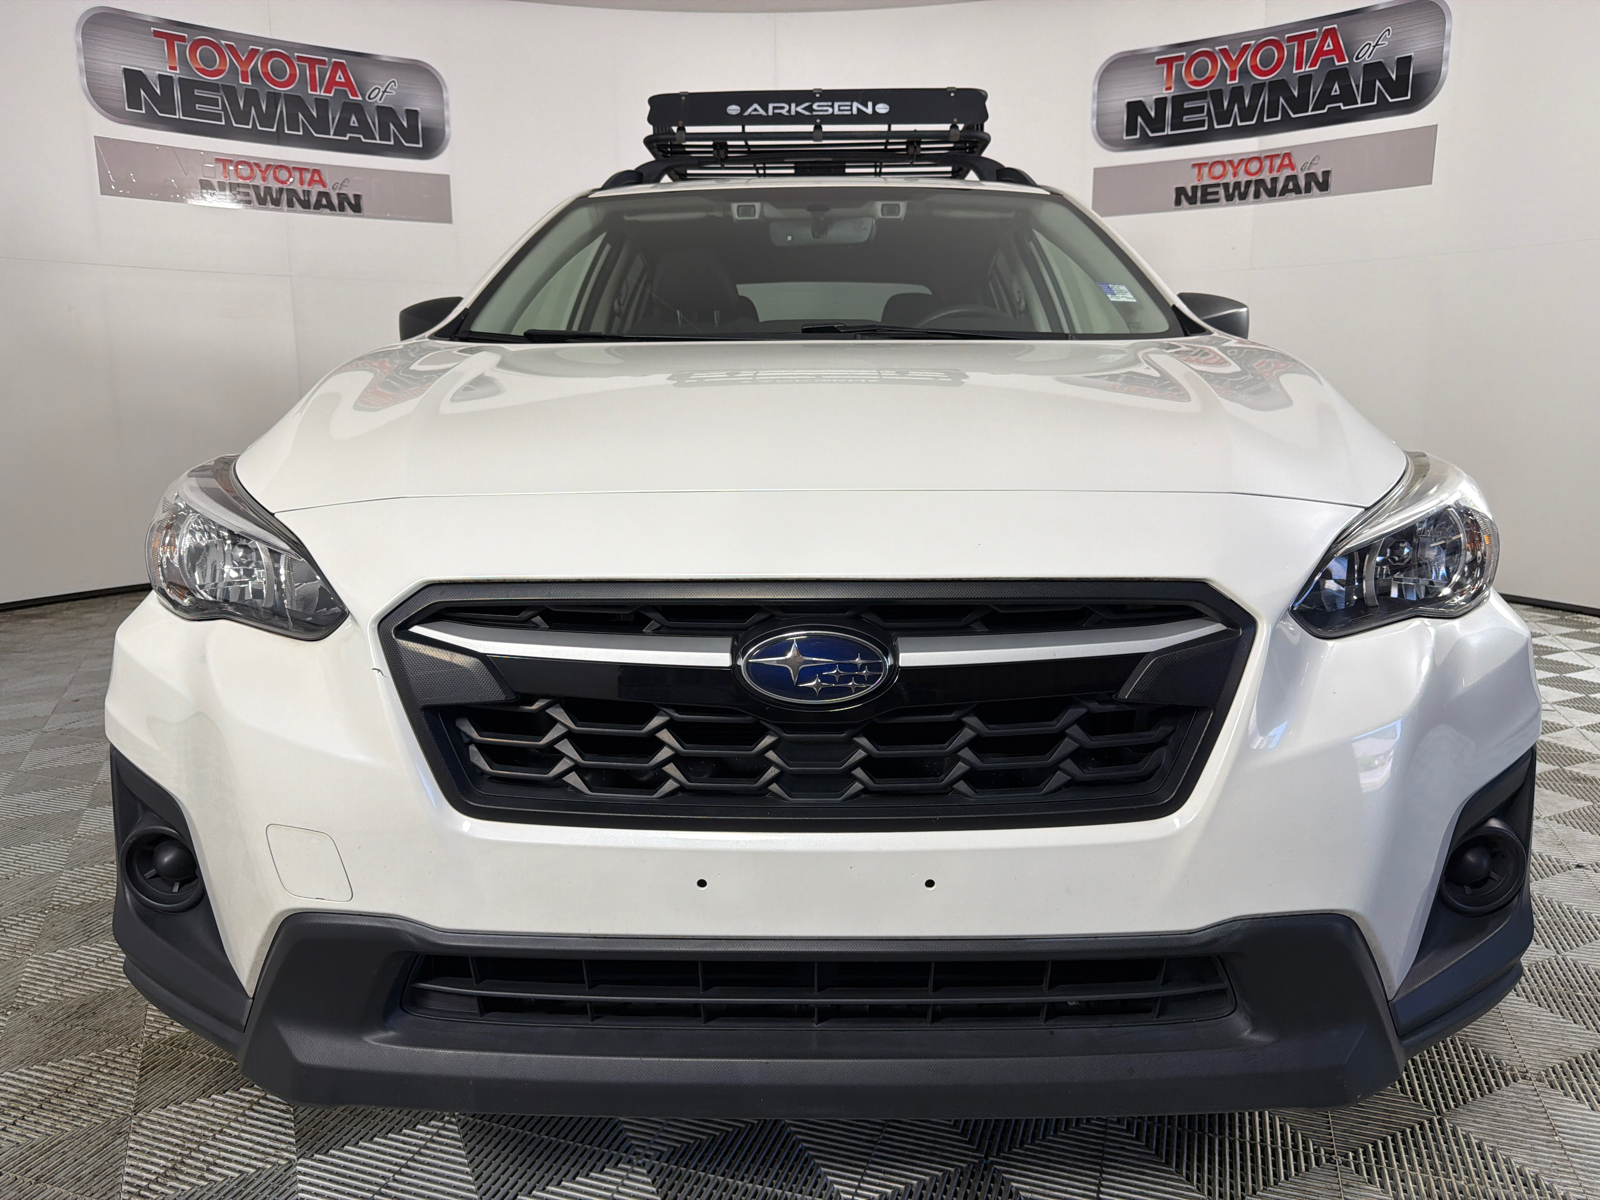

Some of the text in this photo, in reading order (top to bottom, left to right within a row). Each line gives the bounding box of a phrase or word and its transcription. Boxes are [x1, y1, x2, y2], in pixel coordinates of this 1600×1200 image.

[151, 27, 397, 103] TOYOTA of
[1155, 25, 1392, 92] TOYOTA of
[121, 66, 423, 147] NEWNAN
[743, 102, 873, 116] ARKSEN
[1123, 54, 1414, 139] NEWNAN
[215, 157, 350, 191] TOYOTA of
[1191, 152, 1320, 182] TOYOTA of
[199, 178, 362, 213] NEWNAN
[1174, 170, 1331, 207] NEWNAN
